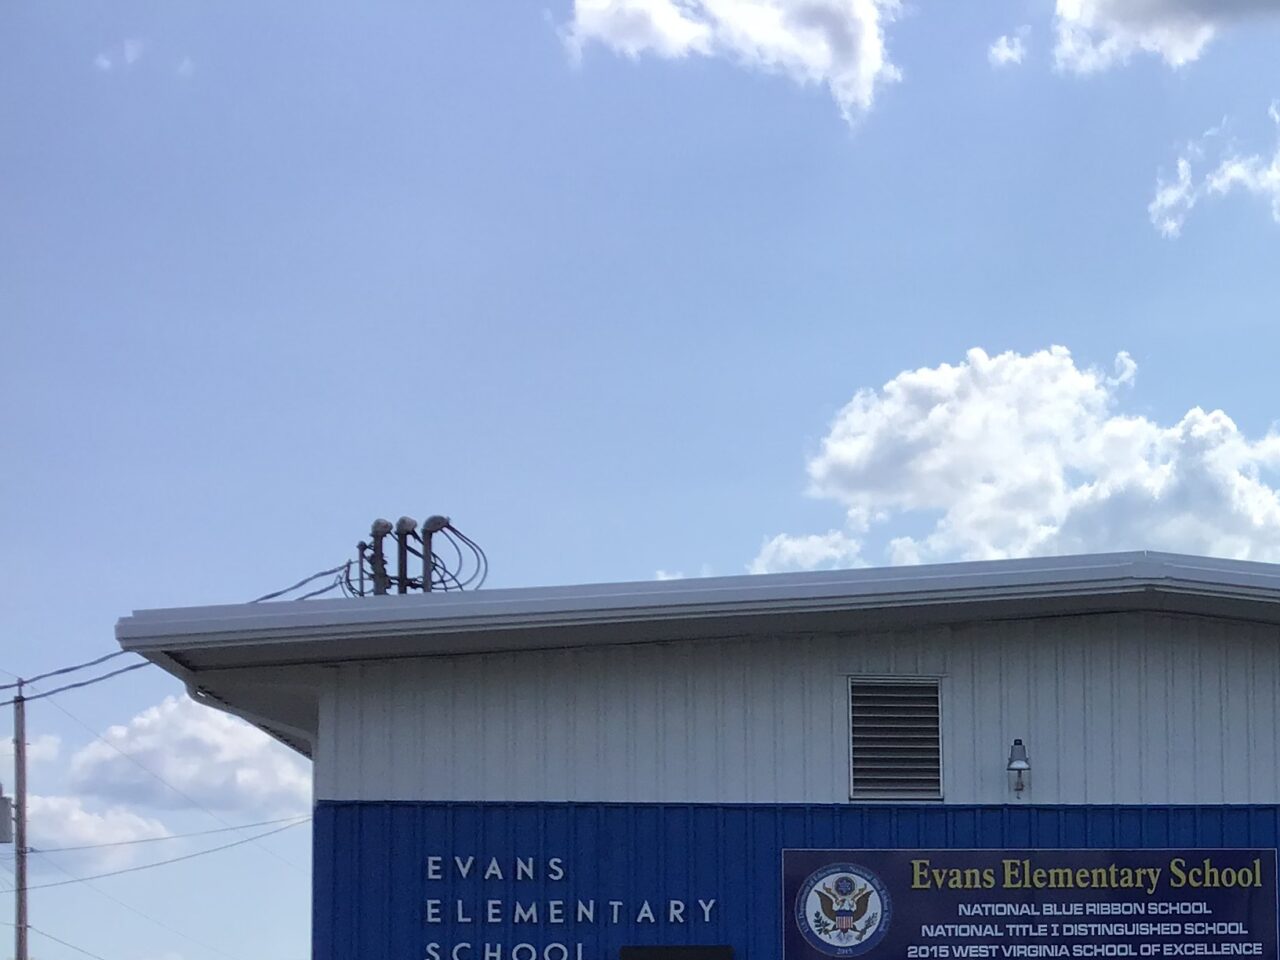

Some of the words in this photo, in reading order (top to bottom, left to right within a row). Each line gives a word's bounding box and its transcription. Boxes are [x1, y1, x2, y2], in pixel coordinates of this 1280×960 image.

[426, 856, 564, 880] EVANS
[911, 859, 995, 889] Evans
[1002, 859, 1161, 895] Elementary
[1169, 858, 1262, 888] School
[426, 899, 716, 923] ELEMENTARY
[958, 903, 1040, 916] NATIONAL
[1042, 903, 1083, 915] BLUE
[1085, 903, 1145, 915] RIBBON
[1147, 902, 1212, 915] SCHOOL
[921, 924, 1003, 937] NATIONAL
[1006, 924, 1047, 936] TITLE
[1051, 924, 1060, 936] I
[1062, 923, 1182, 936] DISTINGUISHED
[1184, 922, 1248, 935] SCHOOL
[907, 945, 949, 958] 2015
[951, 945, 999, 957] WEST
[1001, 945, 1070, 957] VIRGINIA
[1072, 944, 1138, 957] SCHOOL
[1139, 944, 1161, 956] OF
[1163, 943, 1263, 956] EXCELLENCE
